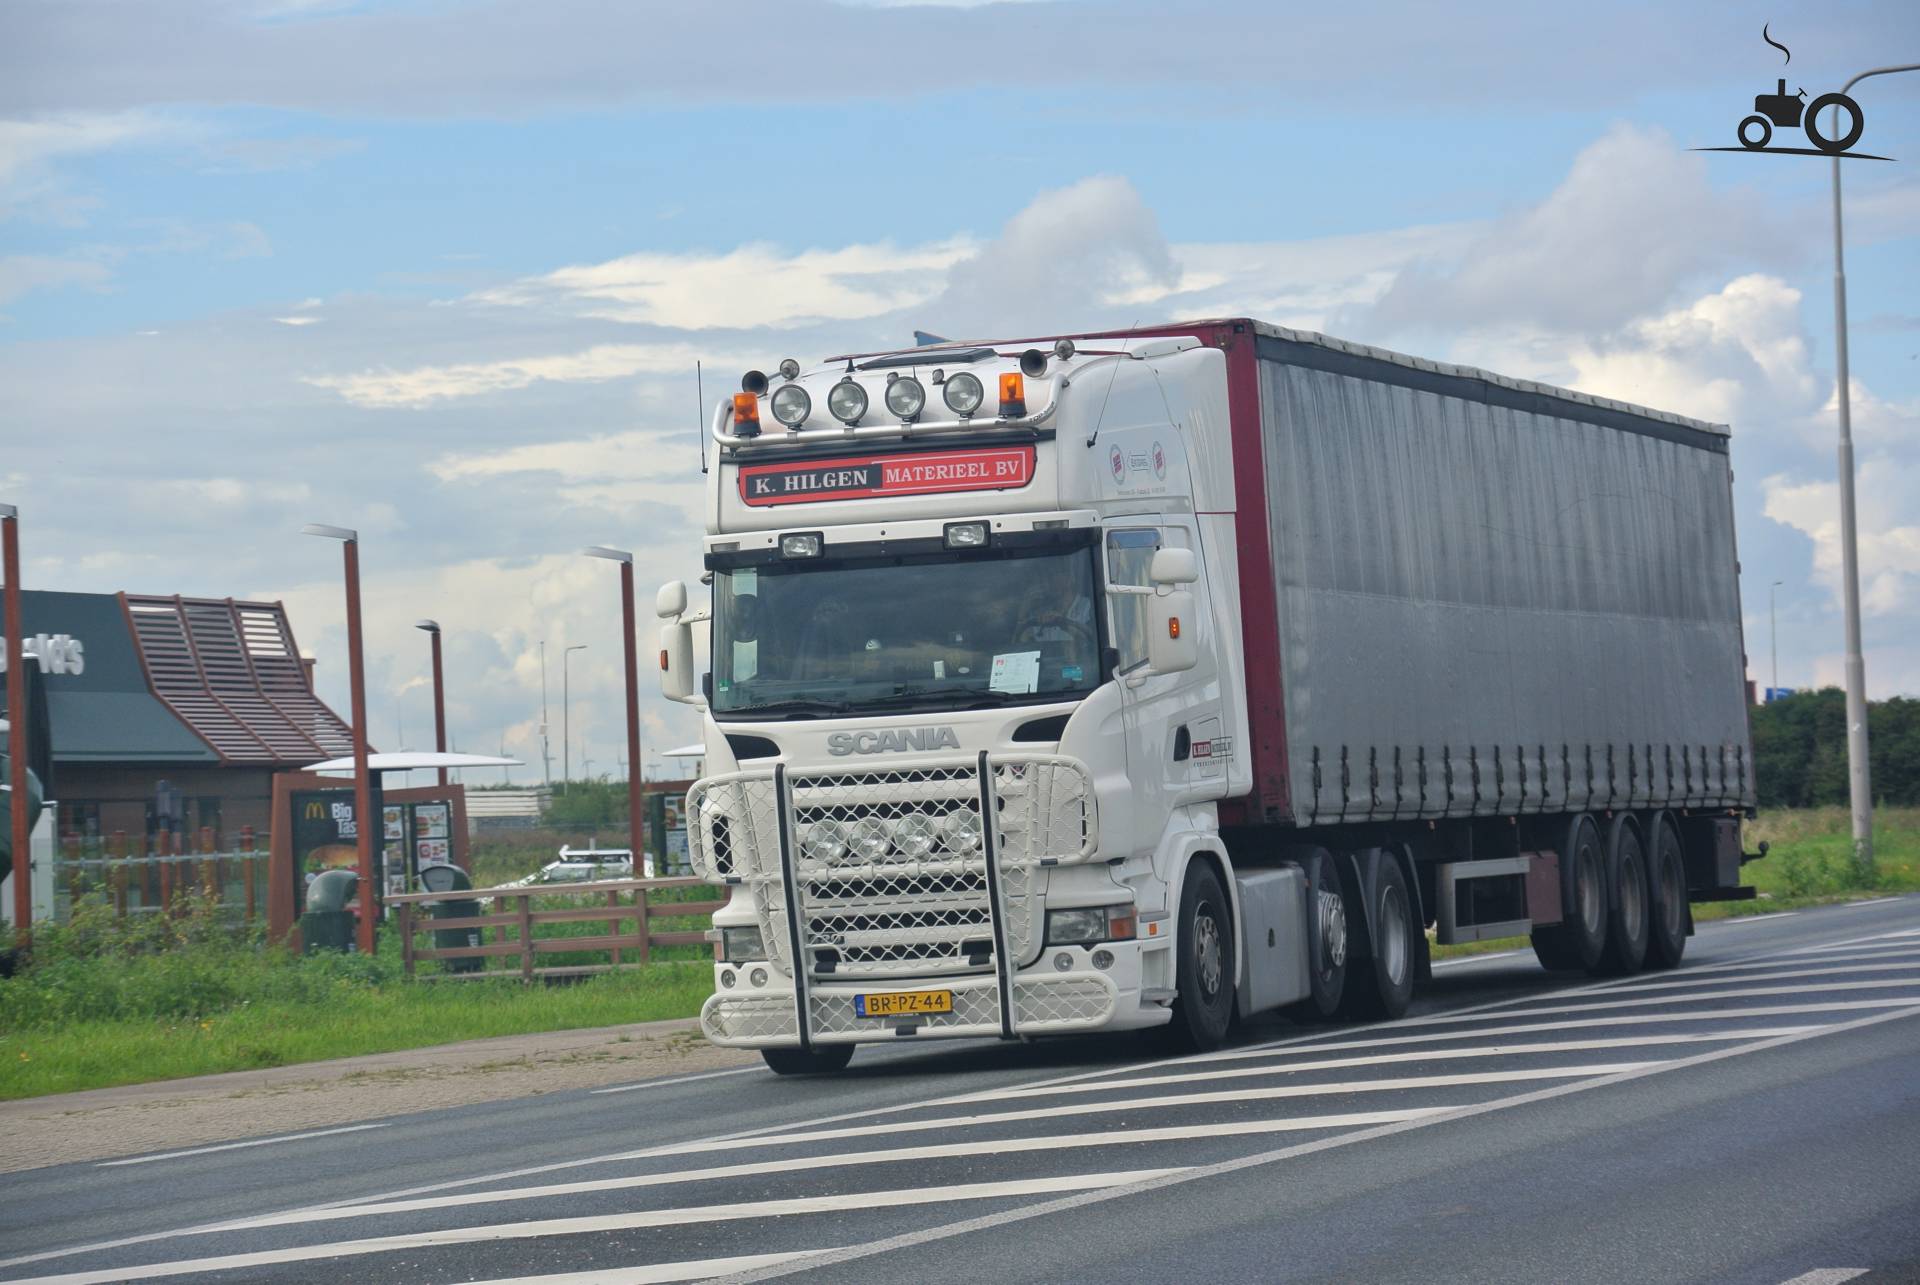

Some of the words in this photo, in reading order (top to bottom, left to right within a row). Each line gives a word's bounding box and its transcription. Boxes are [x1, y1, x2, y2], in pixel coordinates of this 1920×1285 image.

[755, 478, 777, 494] K.
[784, 470, 868, 491] HILGEN
[886, 462, 990, 483] MATERIEEL
[995, 460, 1019, 476] BV
[827, 727, 960, 756] SCANIA
[331, 802, 352, 822] Big
[336, 818, 357, 834] Tas
